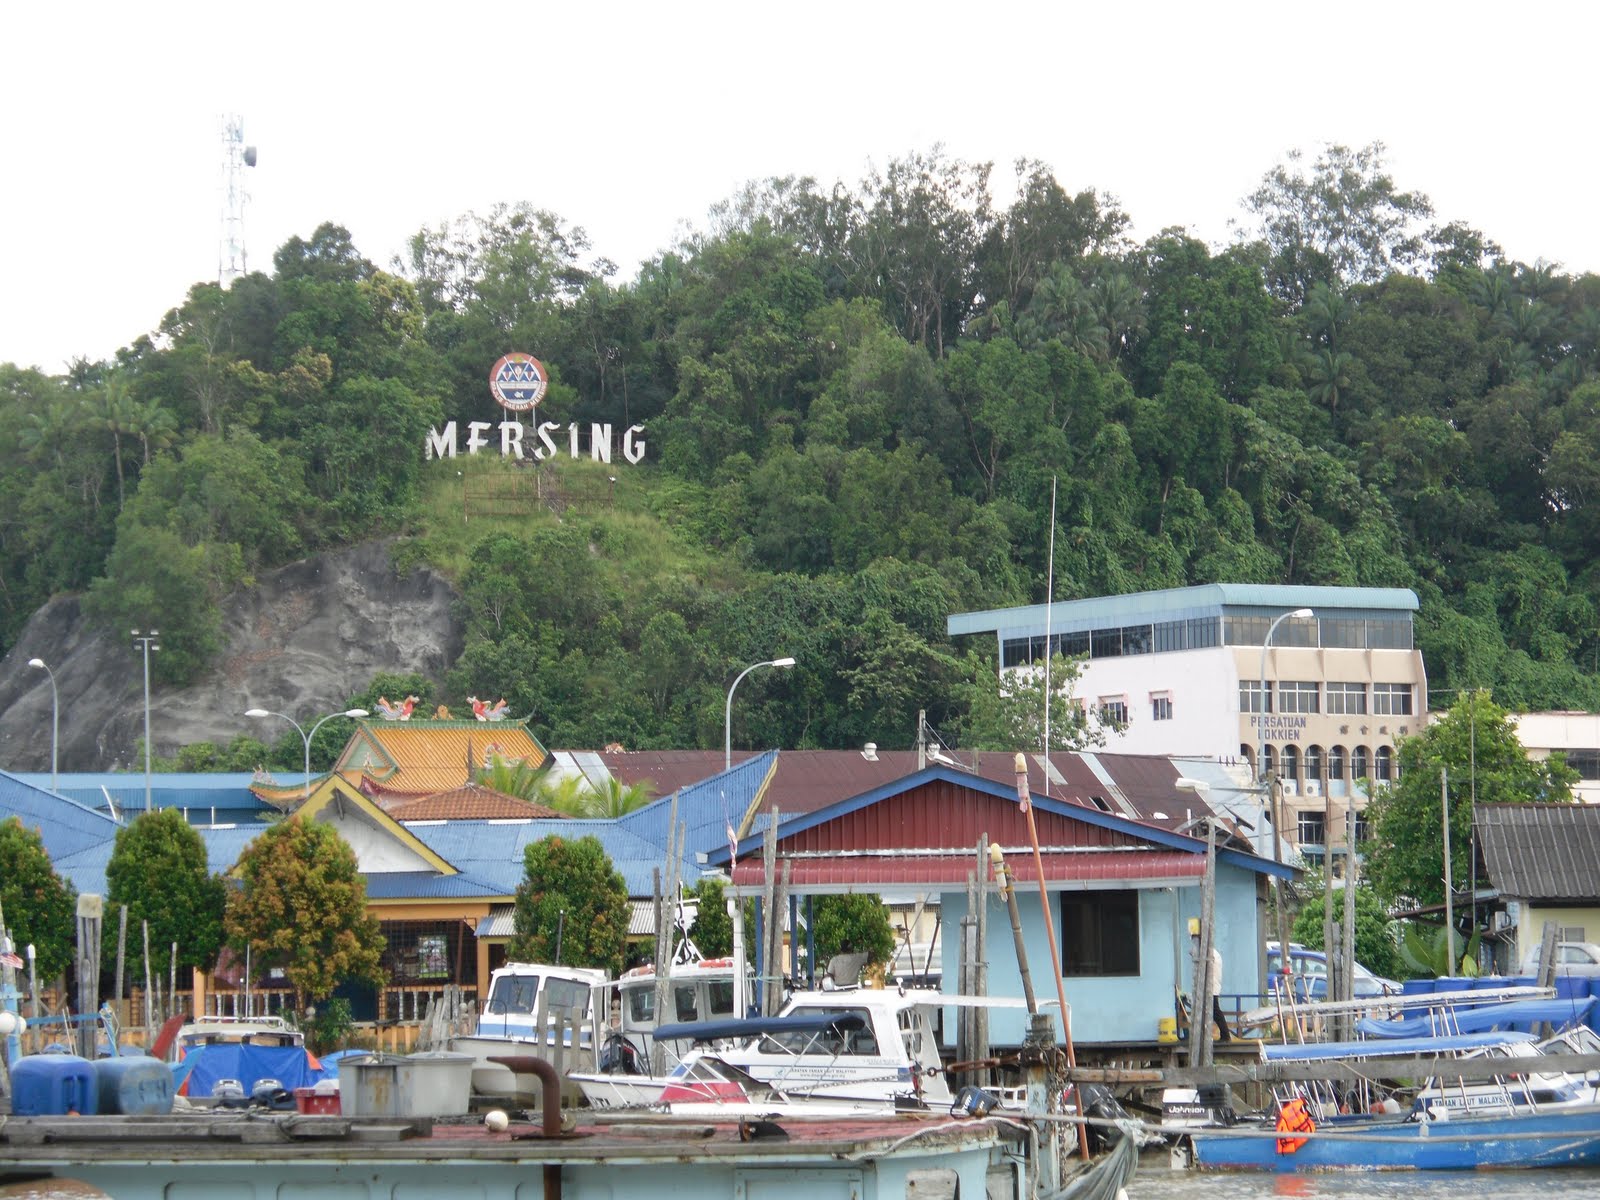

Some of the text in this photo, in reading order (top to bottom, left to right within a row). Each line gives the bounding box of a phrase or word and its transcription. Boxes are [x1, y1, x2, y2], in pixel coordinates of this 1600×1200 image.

[425, 420, 646, 465] MERSING
[1250, 716, 1306, 728] PERSATUAN
[1459, 1098, 1475, 1106] LUT
[1478, 1095, 1511, 1105] MALAYS
